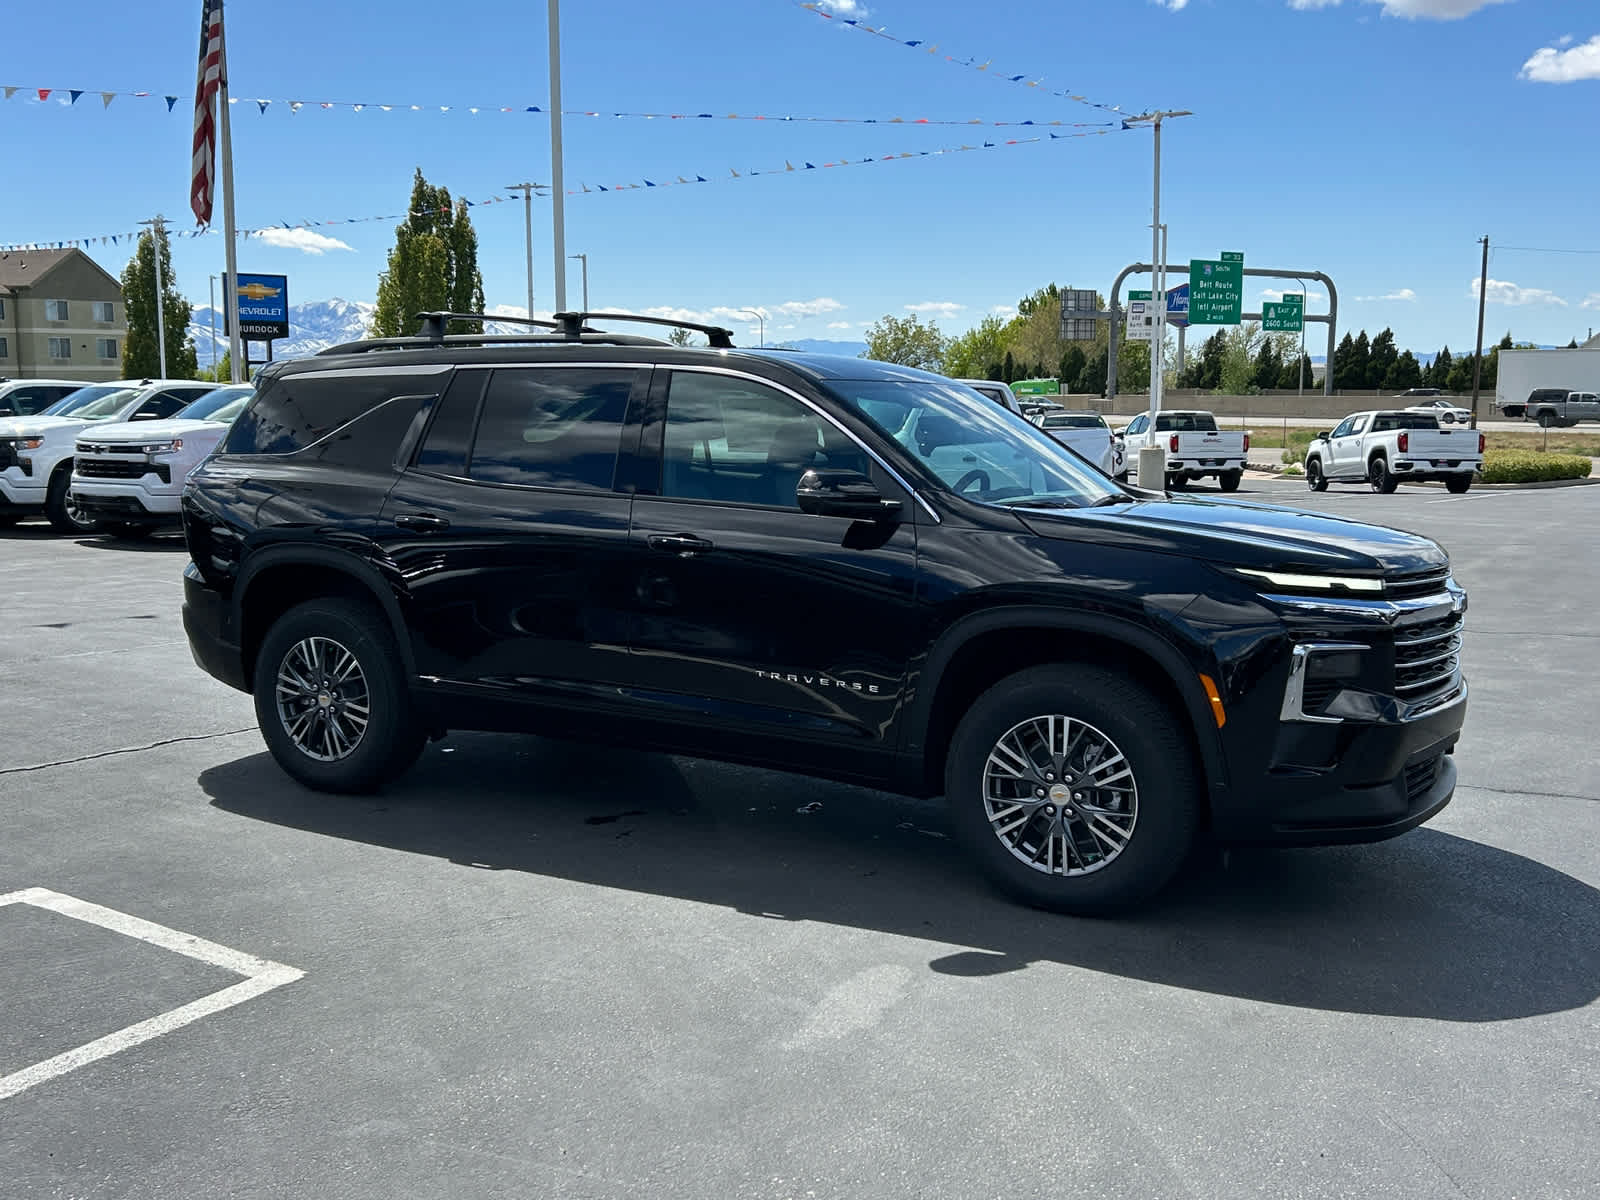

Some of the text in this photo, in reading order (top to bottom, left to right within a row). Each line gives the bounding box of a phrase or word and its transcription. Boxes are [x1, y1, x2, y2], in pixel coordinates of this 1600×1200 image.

[1214, 280, 1233, 289] Route
[1192, 291, 1239, 301] Salt Lake City
[238, 307, 282, 316] HEVROLET
[1211, 303, 1233, 312] Airport
[1265, 319, 1300, 328] 2600 South
[755, 670, 880, 693] TRAVERSE
